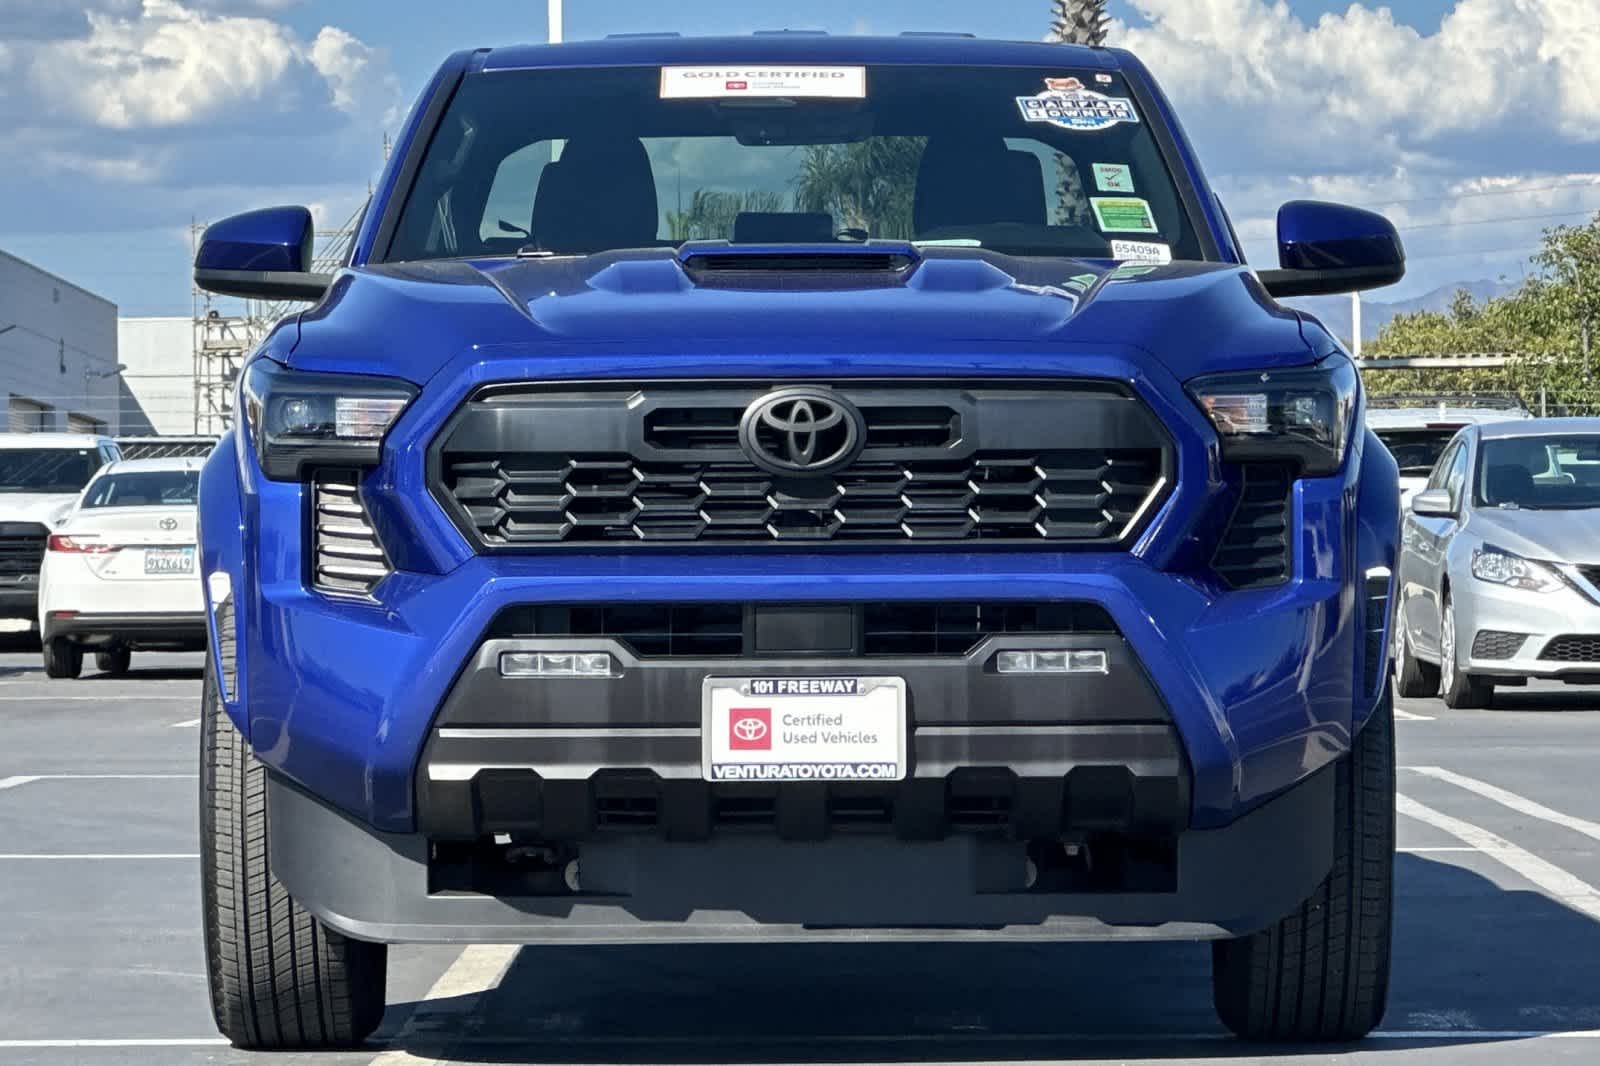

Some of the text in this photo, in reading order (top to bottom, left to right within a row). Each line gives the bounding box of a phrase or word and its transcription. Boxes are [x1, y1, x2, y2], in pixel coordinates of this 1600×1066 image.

[682, 71, 846, 79] GOLD CERTIFIED
[1025, 100, 1128, 110] CARFAX
[1114, 242, 1161, 256] 65409A
[752, 680, 854, 694] 101 FREEWAY
[782, 713, 843, 727] Certified
[782, 731, 878, 745] Used Vehicles
[713, 764, 896, 779] VENTURATOYOTA.COM
